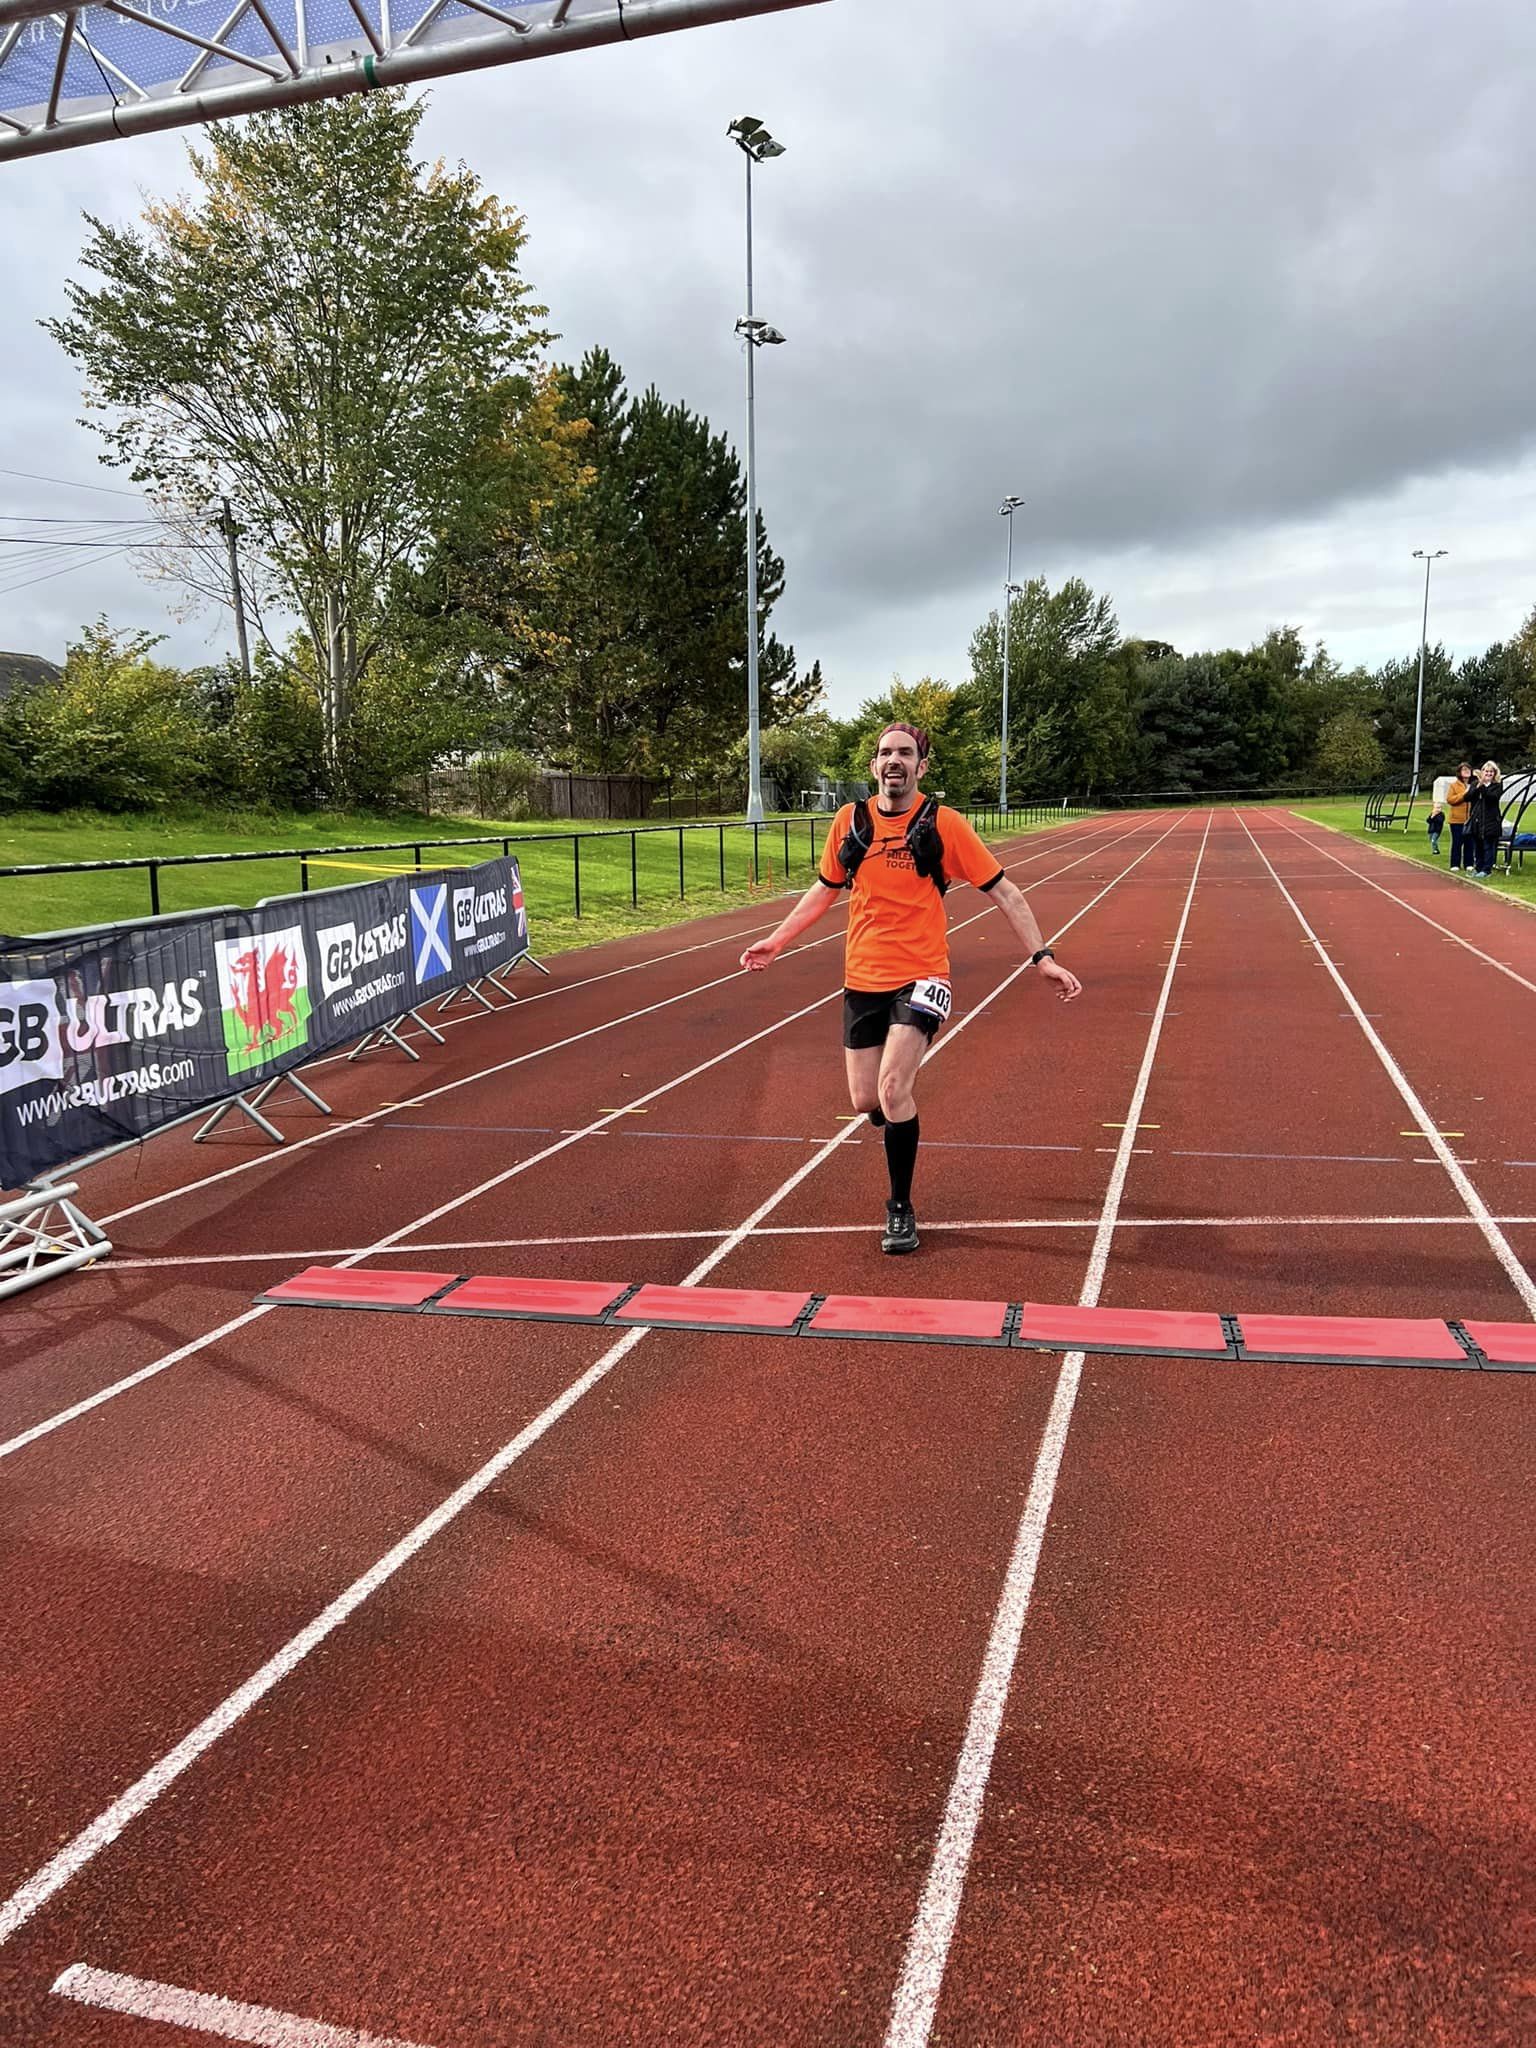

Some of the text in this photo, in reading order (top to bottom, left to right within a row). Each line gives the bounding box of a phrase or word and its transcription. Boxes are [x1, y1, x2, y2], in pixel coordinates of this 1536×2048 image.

[457, 887, 507, 928] GB ULTRAS
[326, 913, 407, 982] GB ULTRAS
[66, 978, 203, 1052] ULTRAS
[923, 984, 951, 1012] 403
